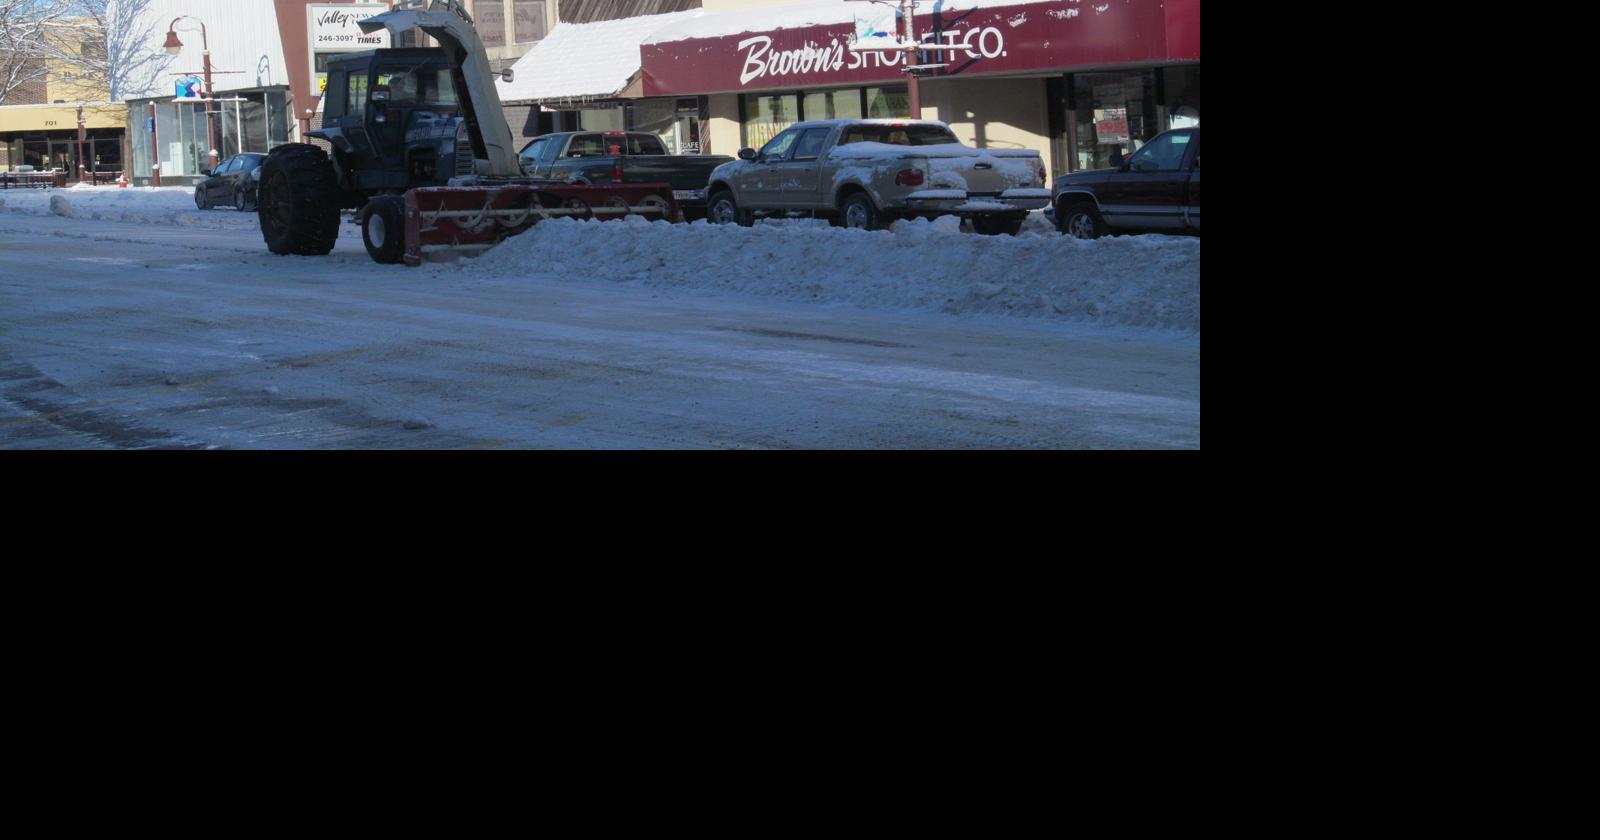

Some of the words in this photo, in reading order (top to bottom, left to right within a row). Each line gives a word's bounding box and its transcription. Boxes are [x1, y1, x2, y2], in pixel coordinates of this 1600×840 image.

[317, 10, 350, 28] Valley
[737, 35, 844, 85] Brown's
[847, 36, 911, 69] SHO
[963, 26, 1007, 59] CO.
